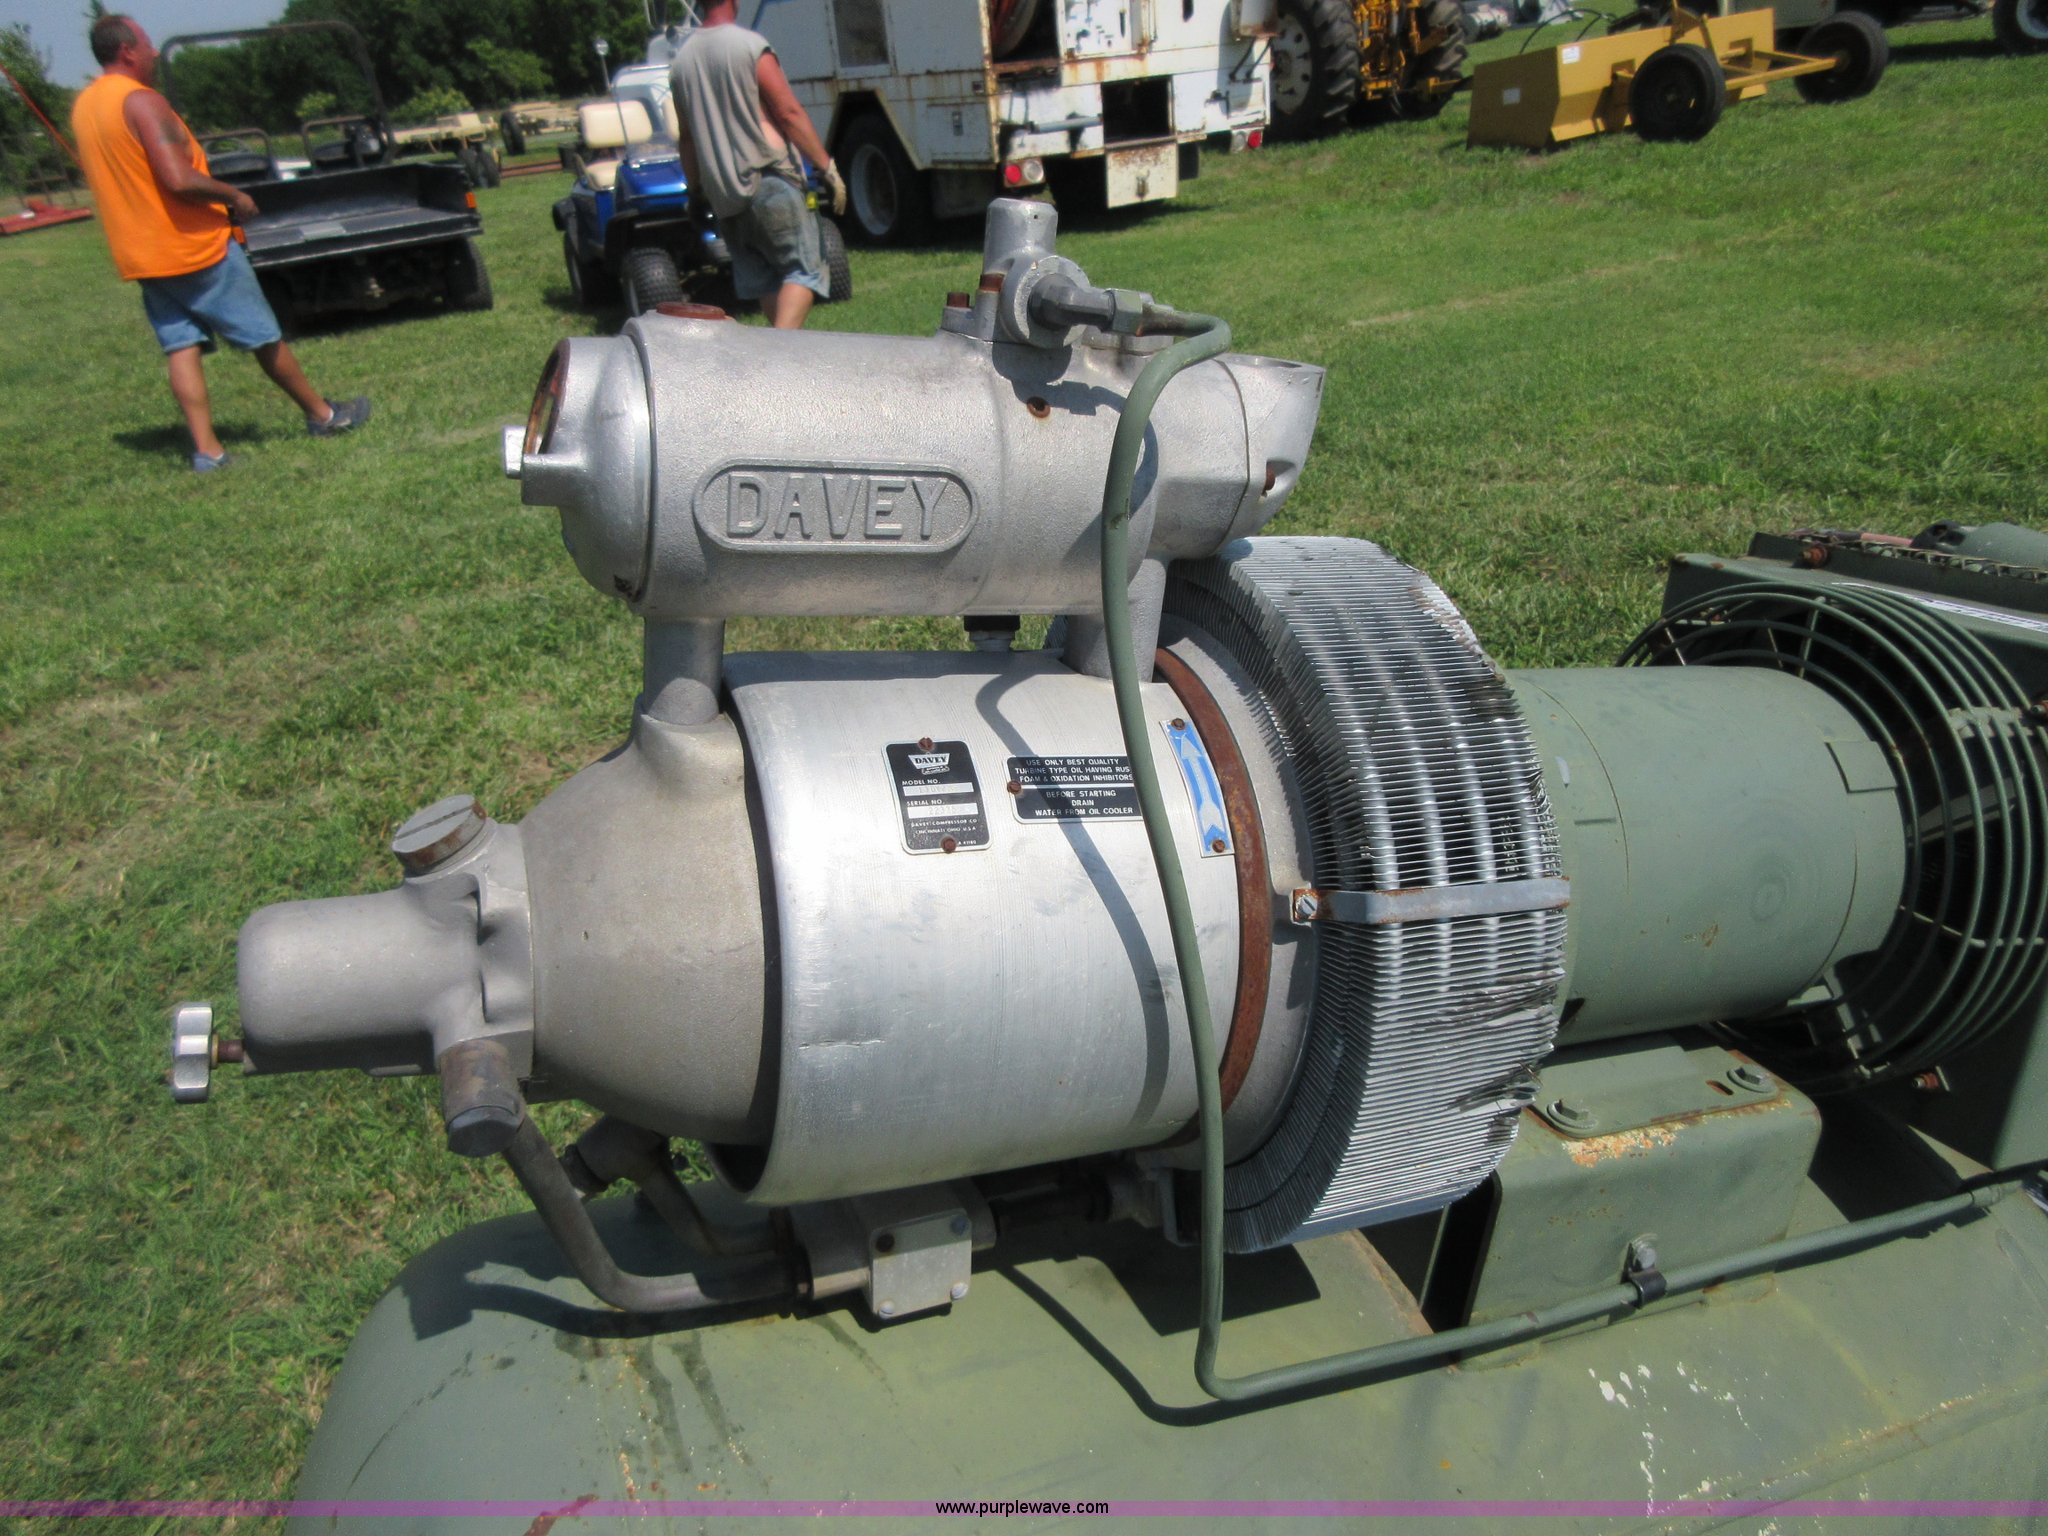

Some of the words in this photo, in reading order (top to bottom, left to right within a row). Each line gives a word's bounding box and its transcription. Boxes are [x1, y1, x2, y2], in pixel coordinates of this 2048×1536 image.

[726, 472, 948, 540] DAVEY
[914, 756, 947, 764] DAVEY
[1019, 775, 1041, 783] FOAM
[1051, 774, 1091, 782] OXIDATION
[1046, 790, 1076, 798] BEFORE
[1035, 808, 1062, 816] WATER
[1103, 807, 1133, 815] COOLER
